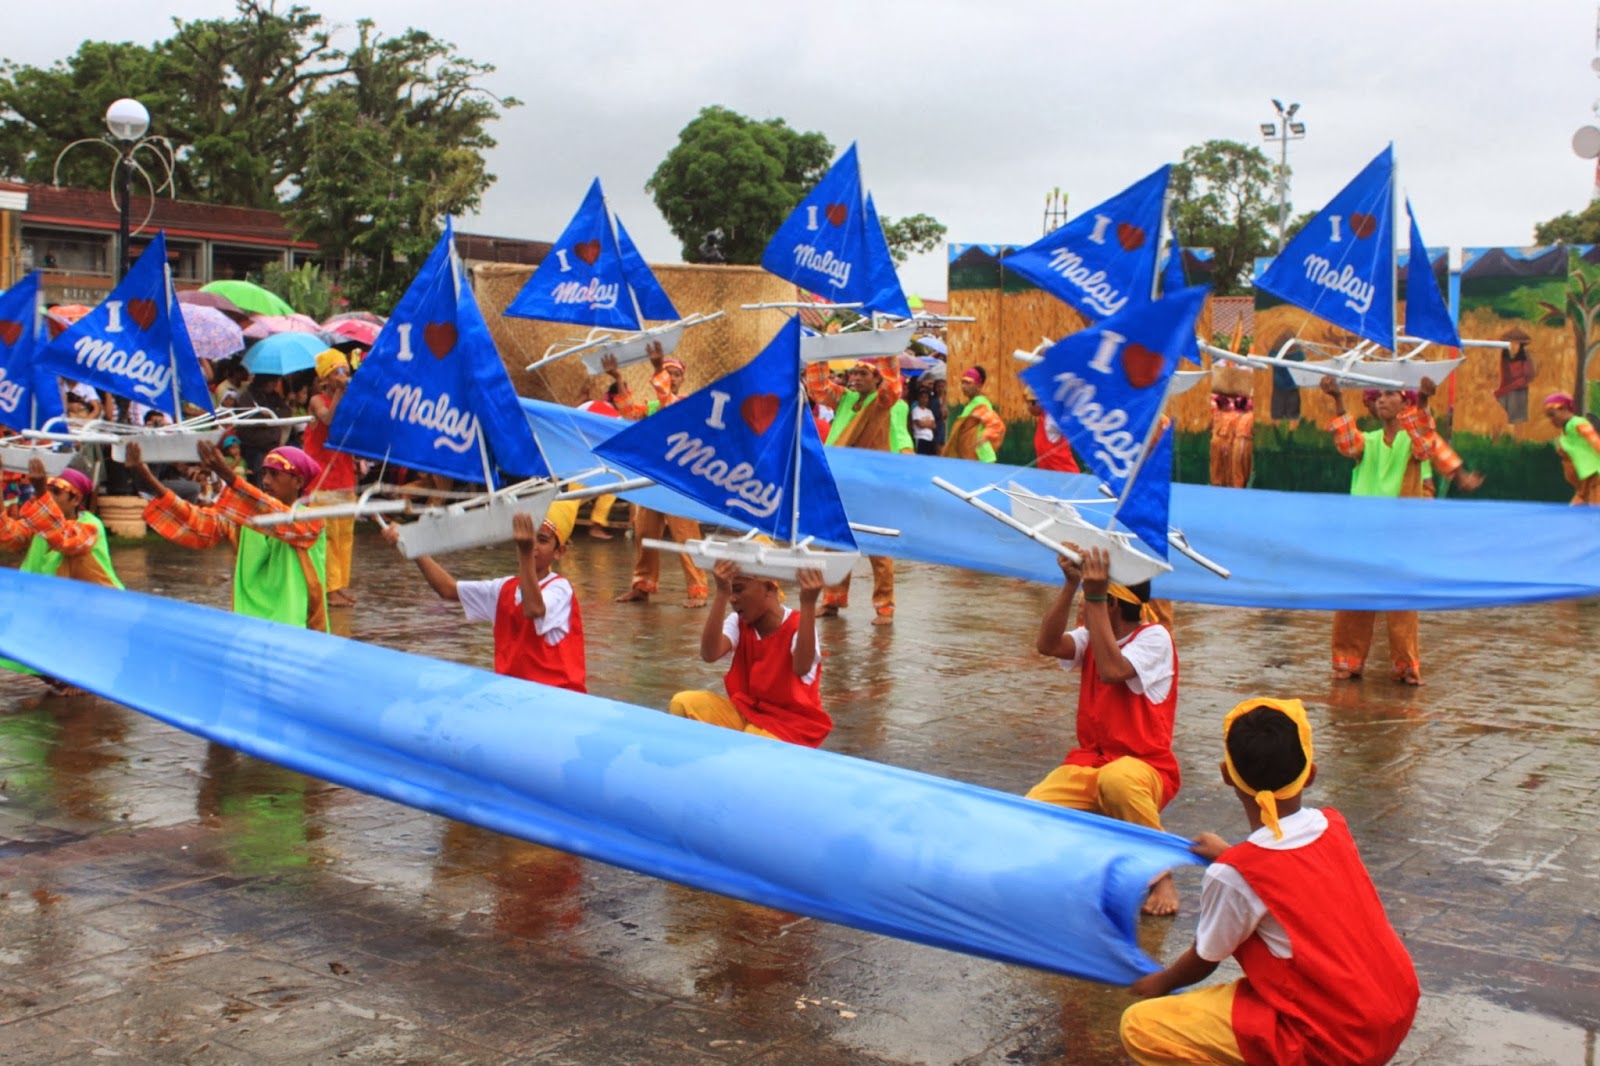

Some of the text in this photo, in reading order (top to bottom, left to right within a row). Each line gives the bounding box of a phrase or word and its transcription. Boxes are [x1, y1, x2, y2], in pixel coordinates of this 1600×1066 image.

[806, 205, 819, 231] I
[1088, 214, 1111, 244] I
[1329, 215, 1342, 242] I
[556, 249, 572, 272] I
[793, 243, 851, 289] Malay
[550, 277, 619, 310] Malay
[1047, 246, 1129, 316] Malay
[1303, 253, 1375, 314] Malay
[104, 300, 123, 333] I
[396, 323, 413, 361] I
[1087, 329, 1127, 374] I
[74, 335, 171, 398] Malay
[386, 383, 477, 453] Malay
[704, 390, 731, 430] I
[666, 431, 783, 518] Malay
